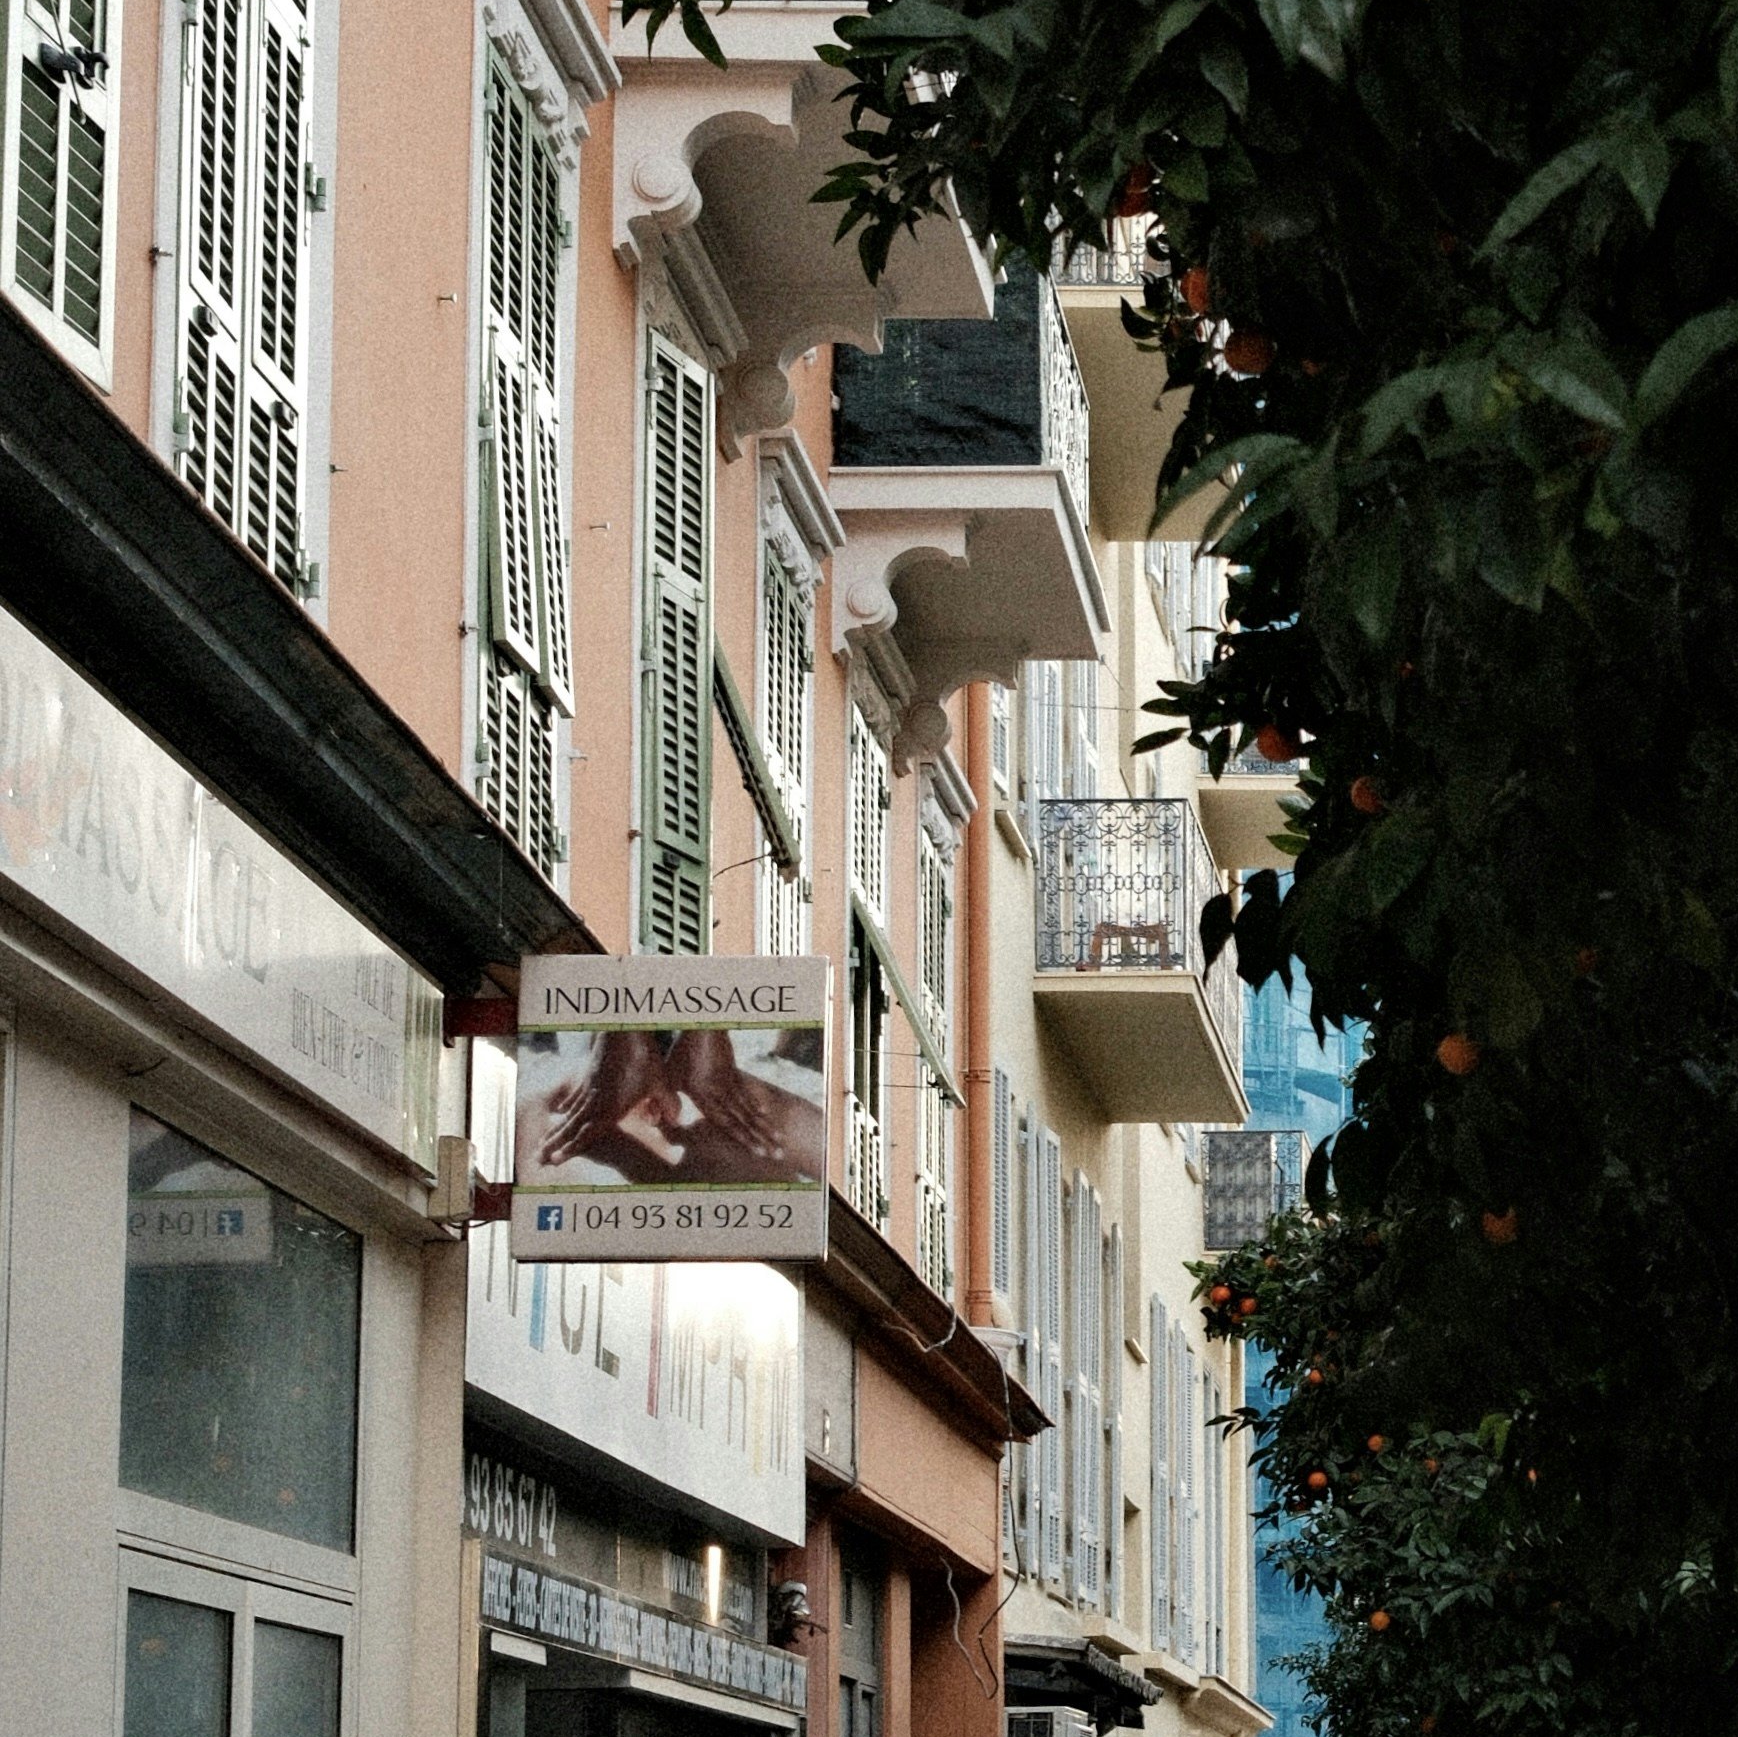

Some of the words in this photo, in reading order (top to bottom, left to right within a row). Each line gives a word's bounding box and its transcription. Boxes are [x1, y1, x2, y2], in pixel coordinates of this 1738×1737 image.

[544, 984, 797, 1015] INDIMASSAGE
[585, 1205, 620, 1230] 04
[631, 1204, 666, 1229] 93
[675, 1204, 703, 1230] 81
[713, 1203, 749, 1229] 92
[758, 1203, 793, 1229] 52
[470, 1452, 491, 1533] 93
[494, 1462, 515, 1542] 85
[518, 1472, 537, 1548] 67
[538, 1481, 558, 1558] 42
